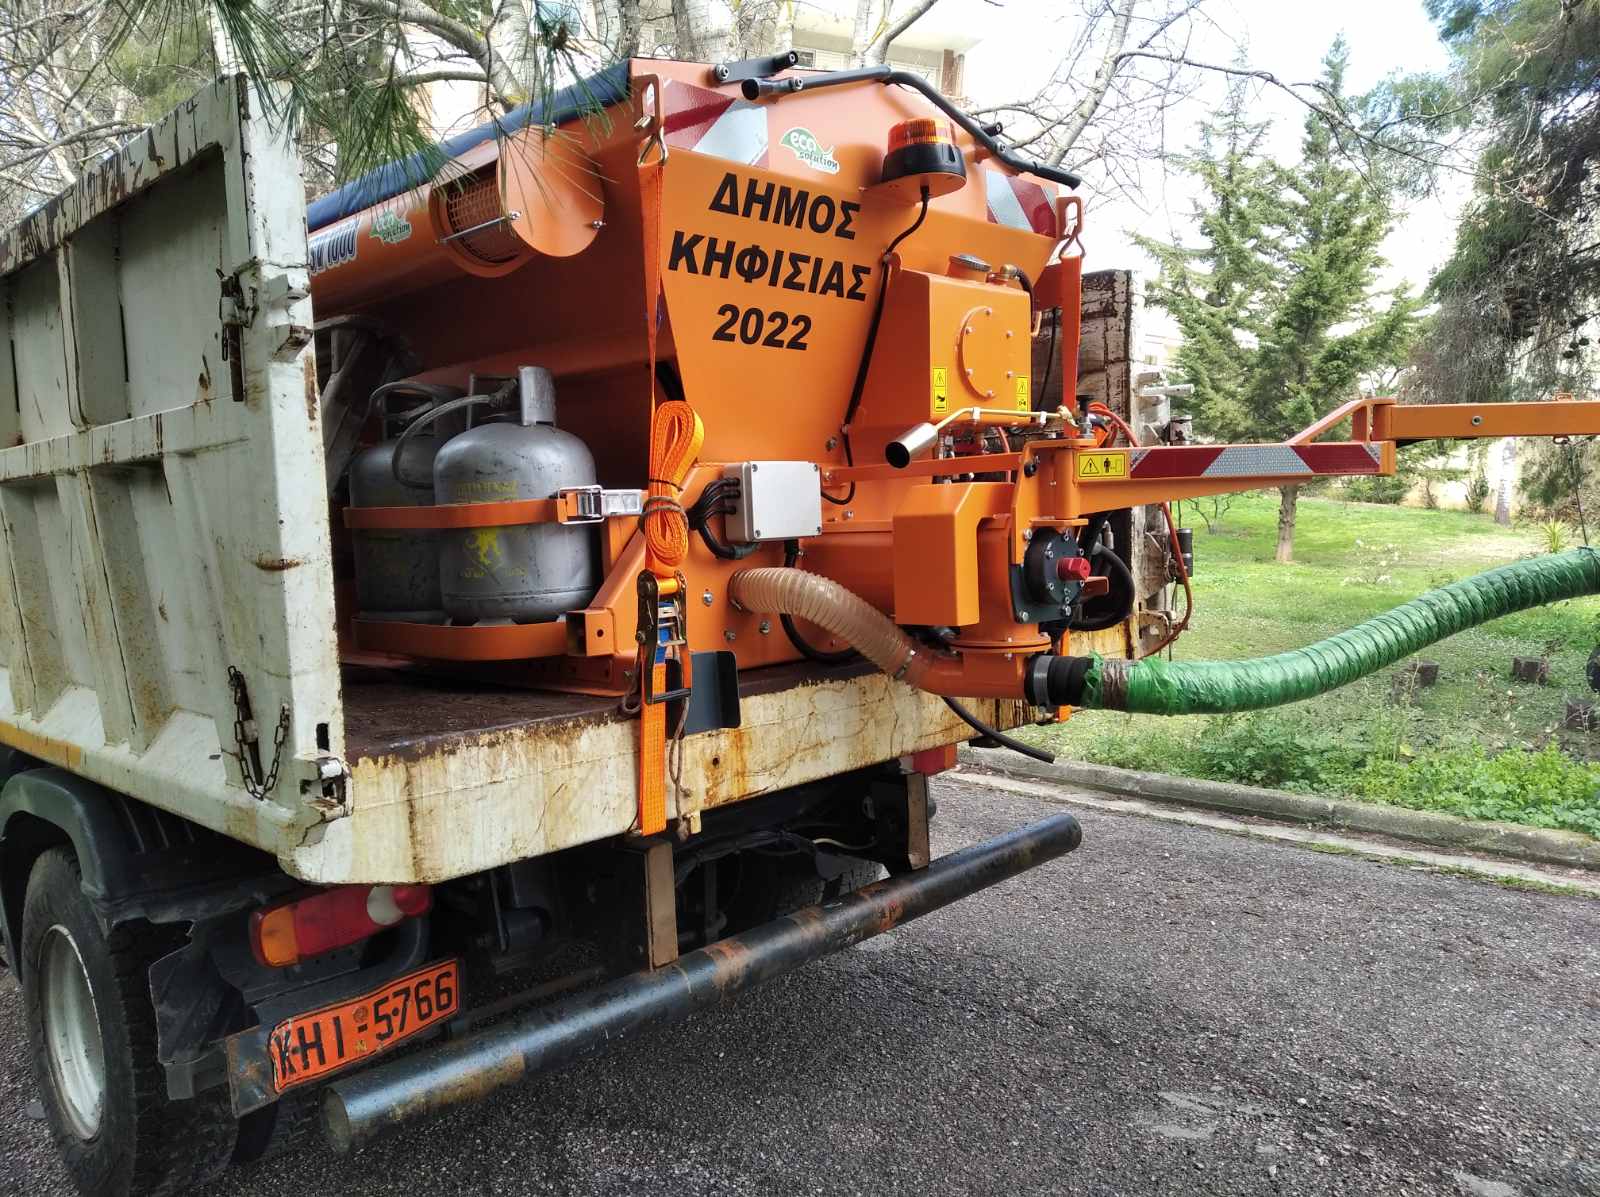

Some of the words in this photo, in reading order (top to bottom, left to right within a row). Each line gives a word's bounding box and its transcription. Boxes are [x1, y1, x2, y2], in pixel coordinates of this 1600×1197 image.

[790, 131, 816, 151] eco
[708, 172, 861, 240] ΔΗΜΟΣ
[668, 230, 872, 301] ΚΗΦΙΣΙΑΣ
[712, 304, 812, 351] 2022
